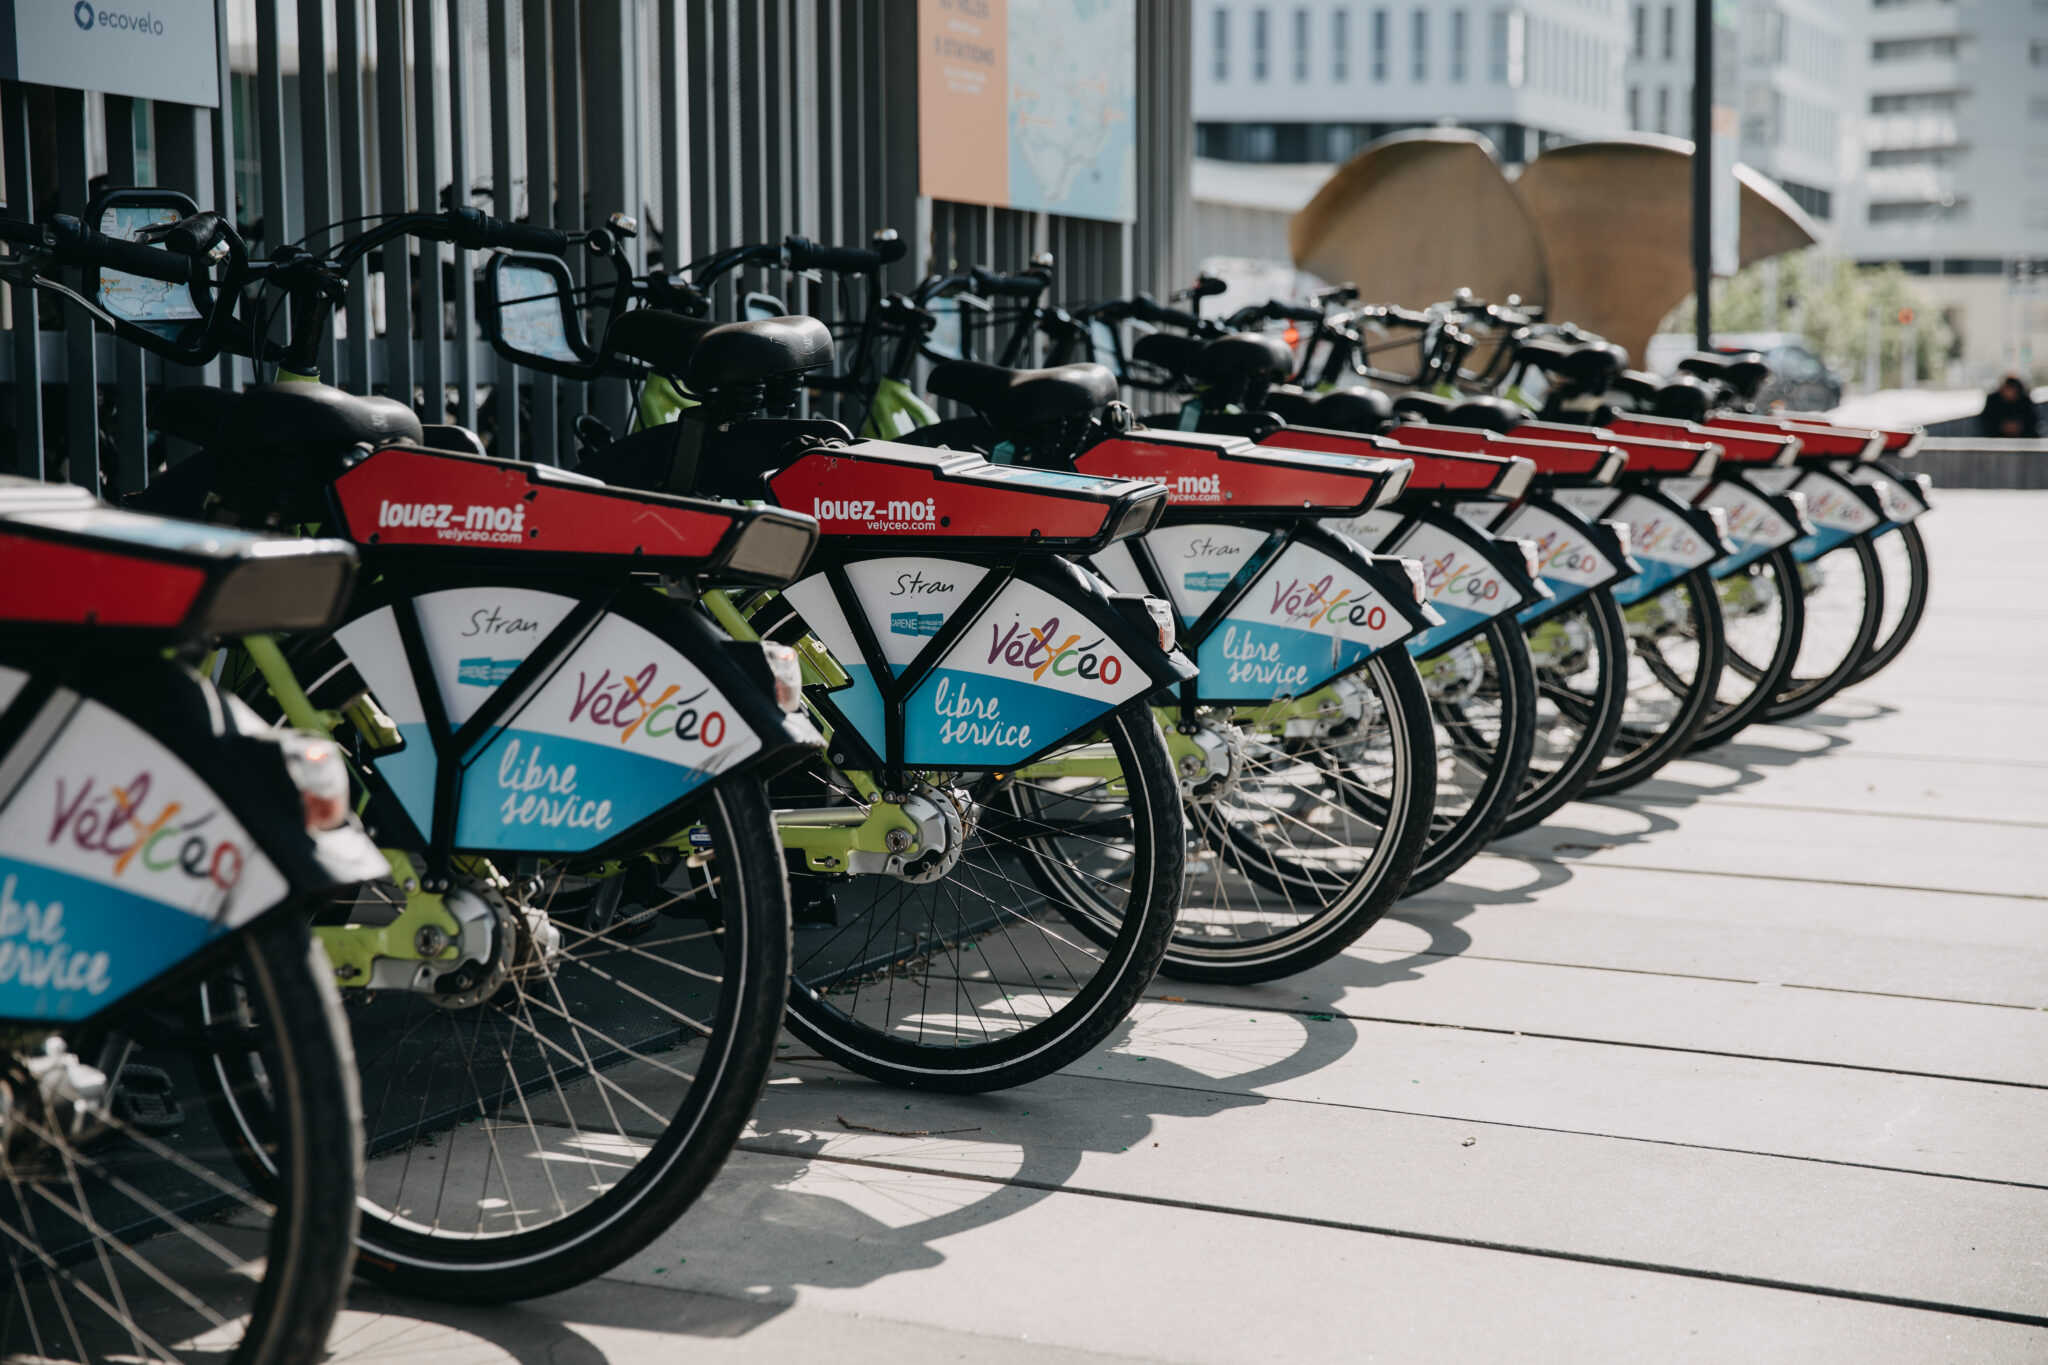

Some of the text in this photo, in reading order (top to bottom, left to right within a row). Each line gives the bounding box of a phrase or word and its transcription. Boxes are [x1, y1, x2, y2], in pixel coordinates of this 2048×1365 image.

[98, 11, 164, 36] ecovelo
[379, 500, 525, 532] louez-moi
[814, 498, 936, 521] louez-moi
[437, 528, 523, 544] velyceo.com
[867, 520, 936, 532] velyceo.com
[1184, 537, 1241, 559] Stran
[890, 571, 954, 596] Stran
[461, 606, 541, 637] Stran
[1223, 626, 1280, 662] libre
[1227, 660, 1309, 685] service
[935, 676, 1000, 720] libre
[939, 719, 1032, 749] service
[498, 739, 577, 794] libre
[500, 792, 612, 829] service
[0, 873, 66, 945] bre
[0, 938, 112, 995] ervice
